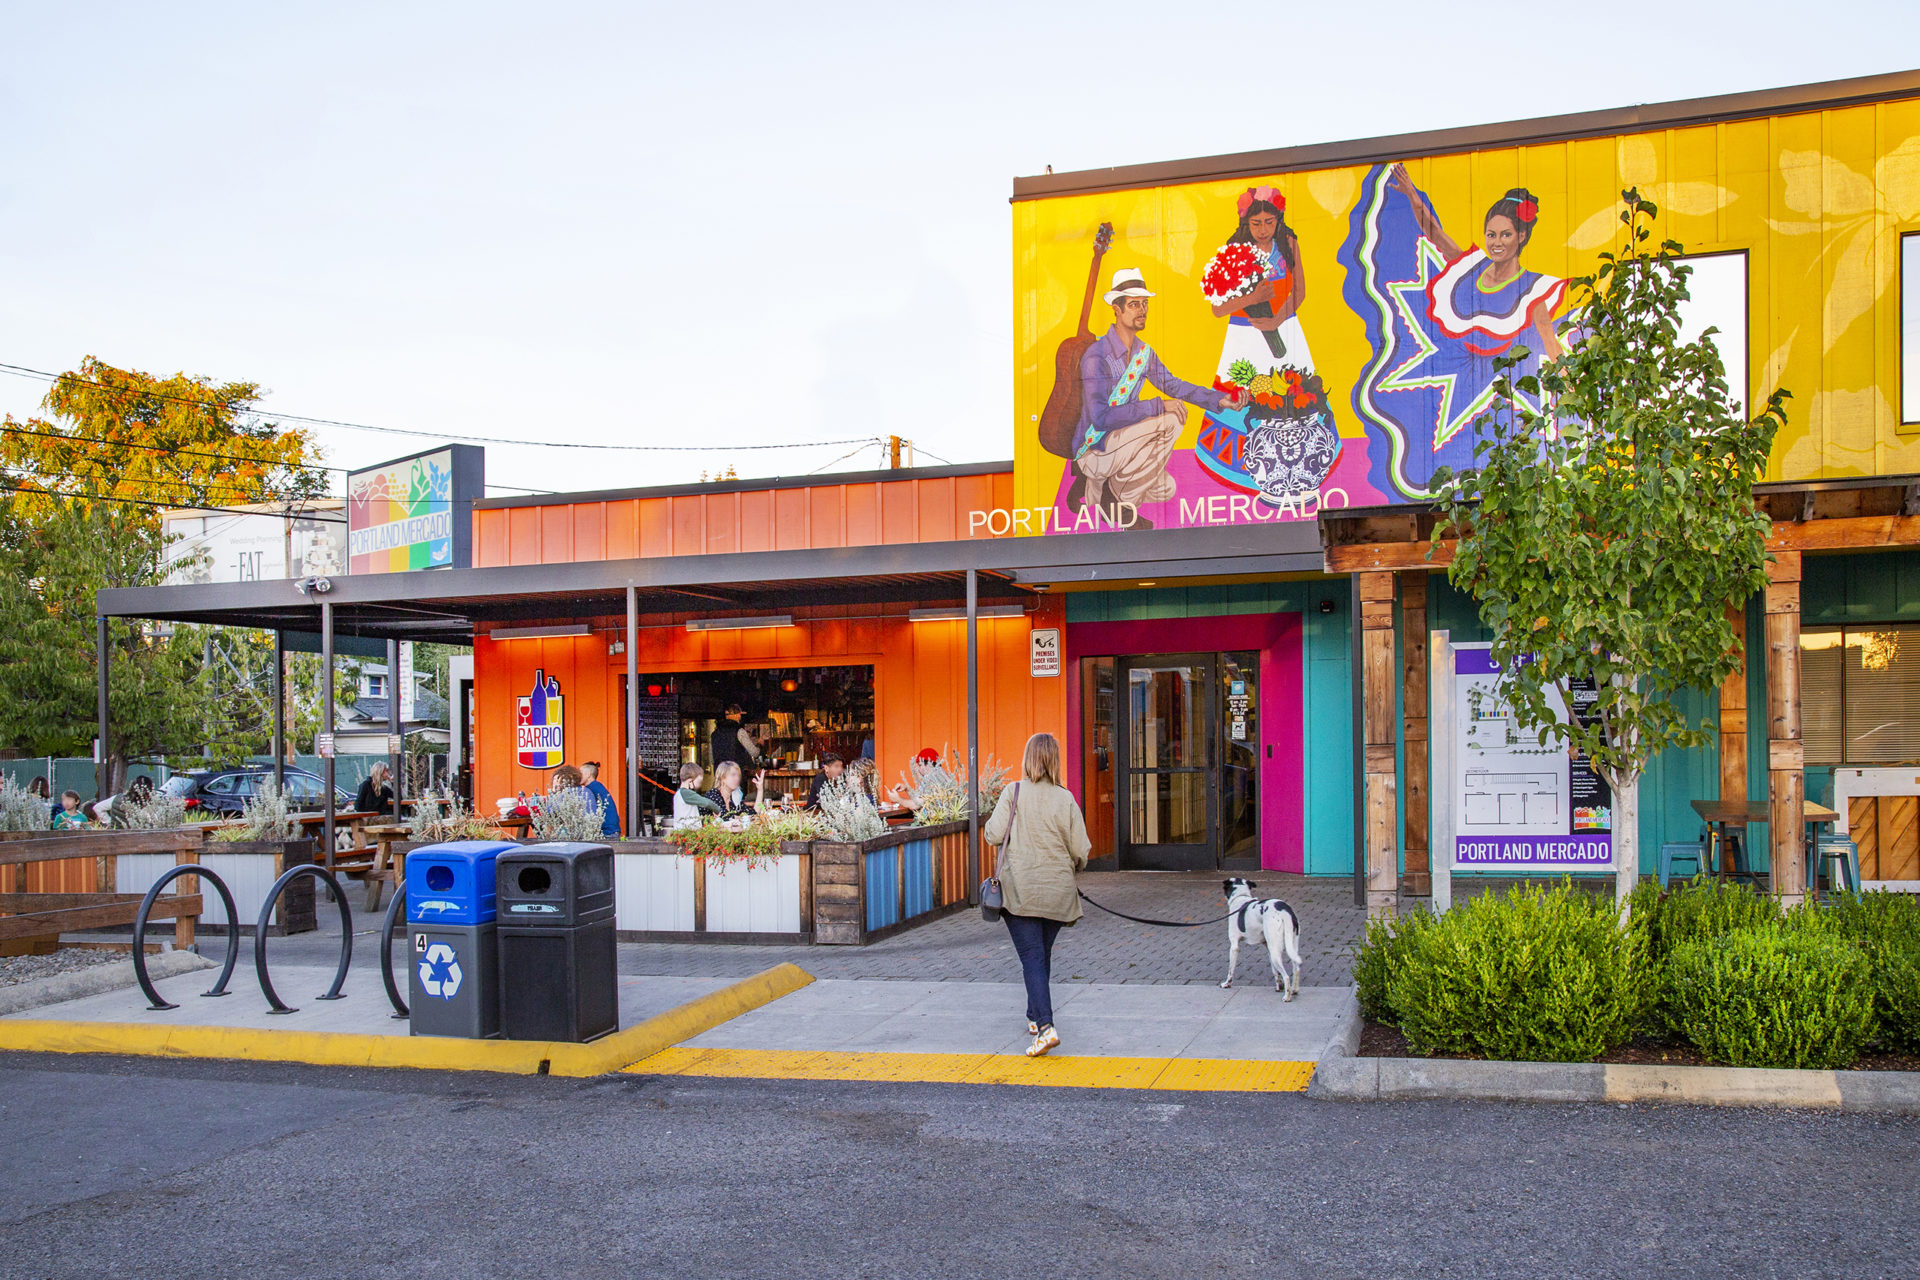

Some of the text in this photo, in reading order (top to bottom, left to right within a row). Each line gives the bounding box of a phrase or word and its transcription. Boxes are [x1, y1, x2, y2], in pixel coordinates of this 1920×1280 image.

[969, 487, 1349, 537] PORTLAND MERCADO
[350, 512, 451, 555] PORTLAND MERCADO
[518, 726, 562, 748] BARRIO
[1458, 842, 1609, 860] PORTLAND MERCADO
[417, 935, 425, 951] 4
